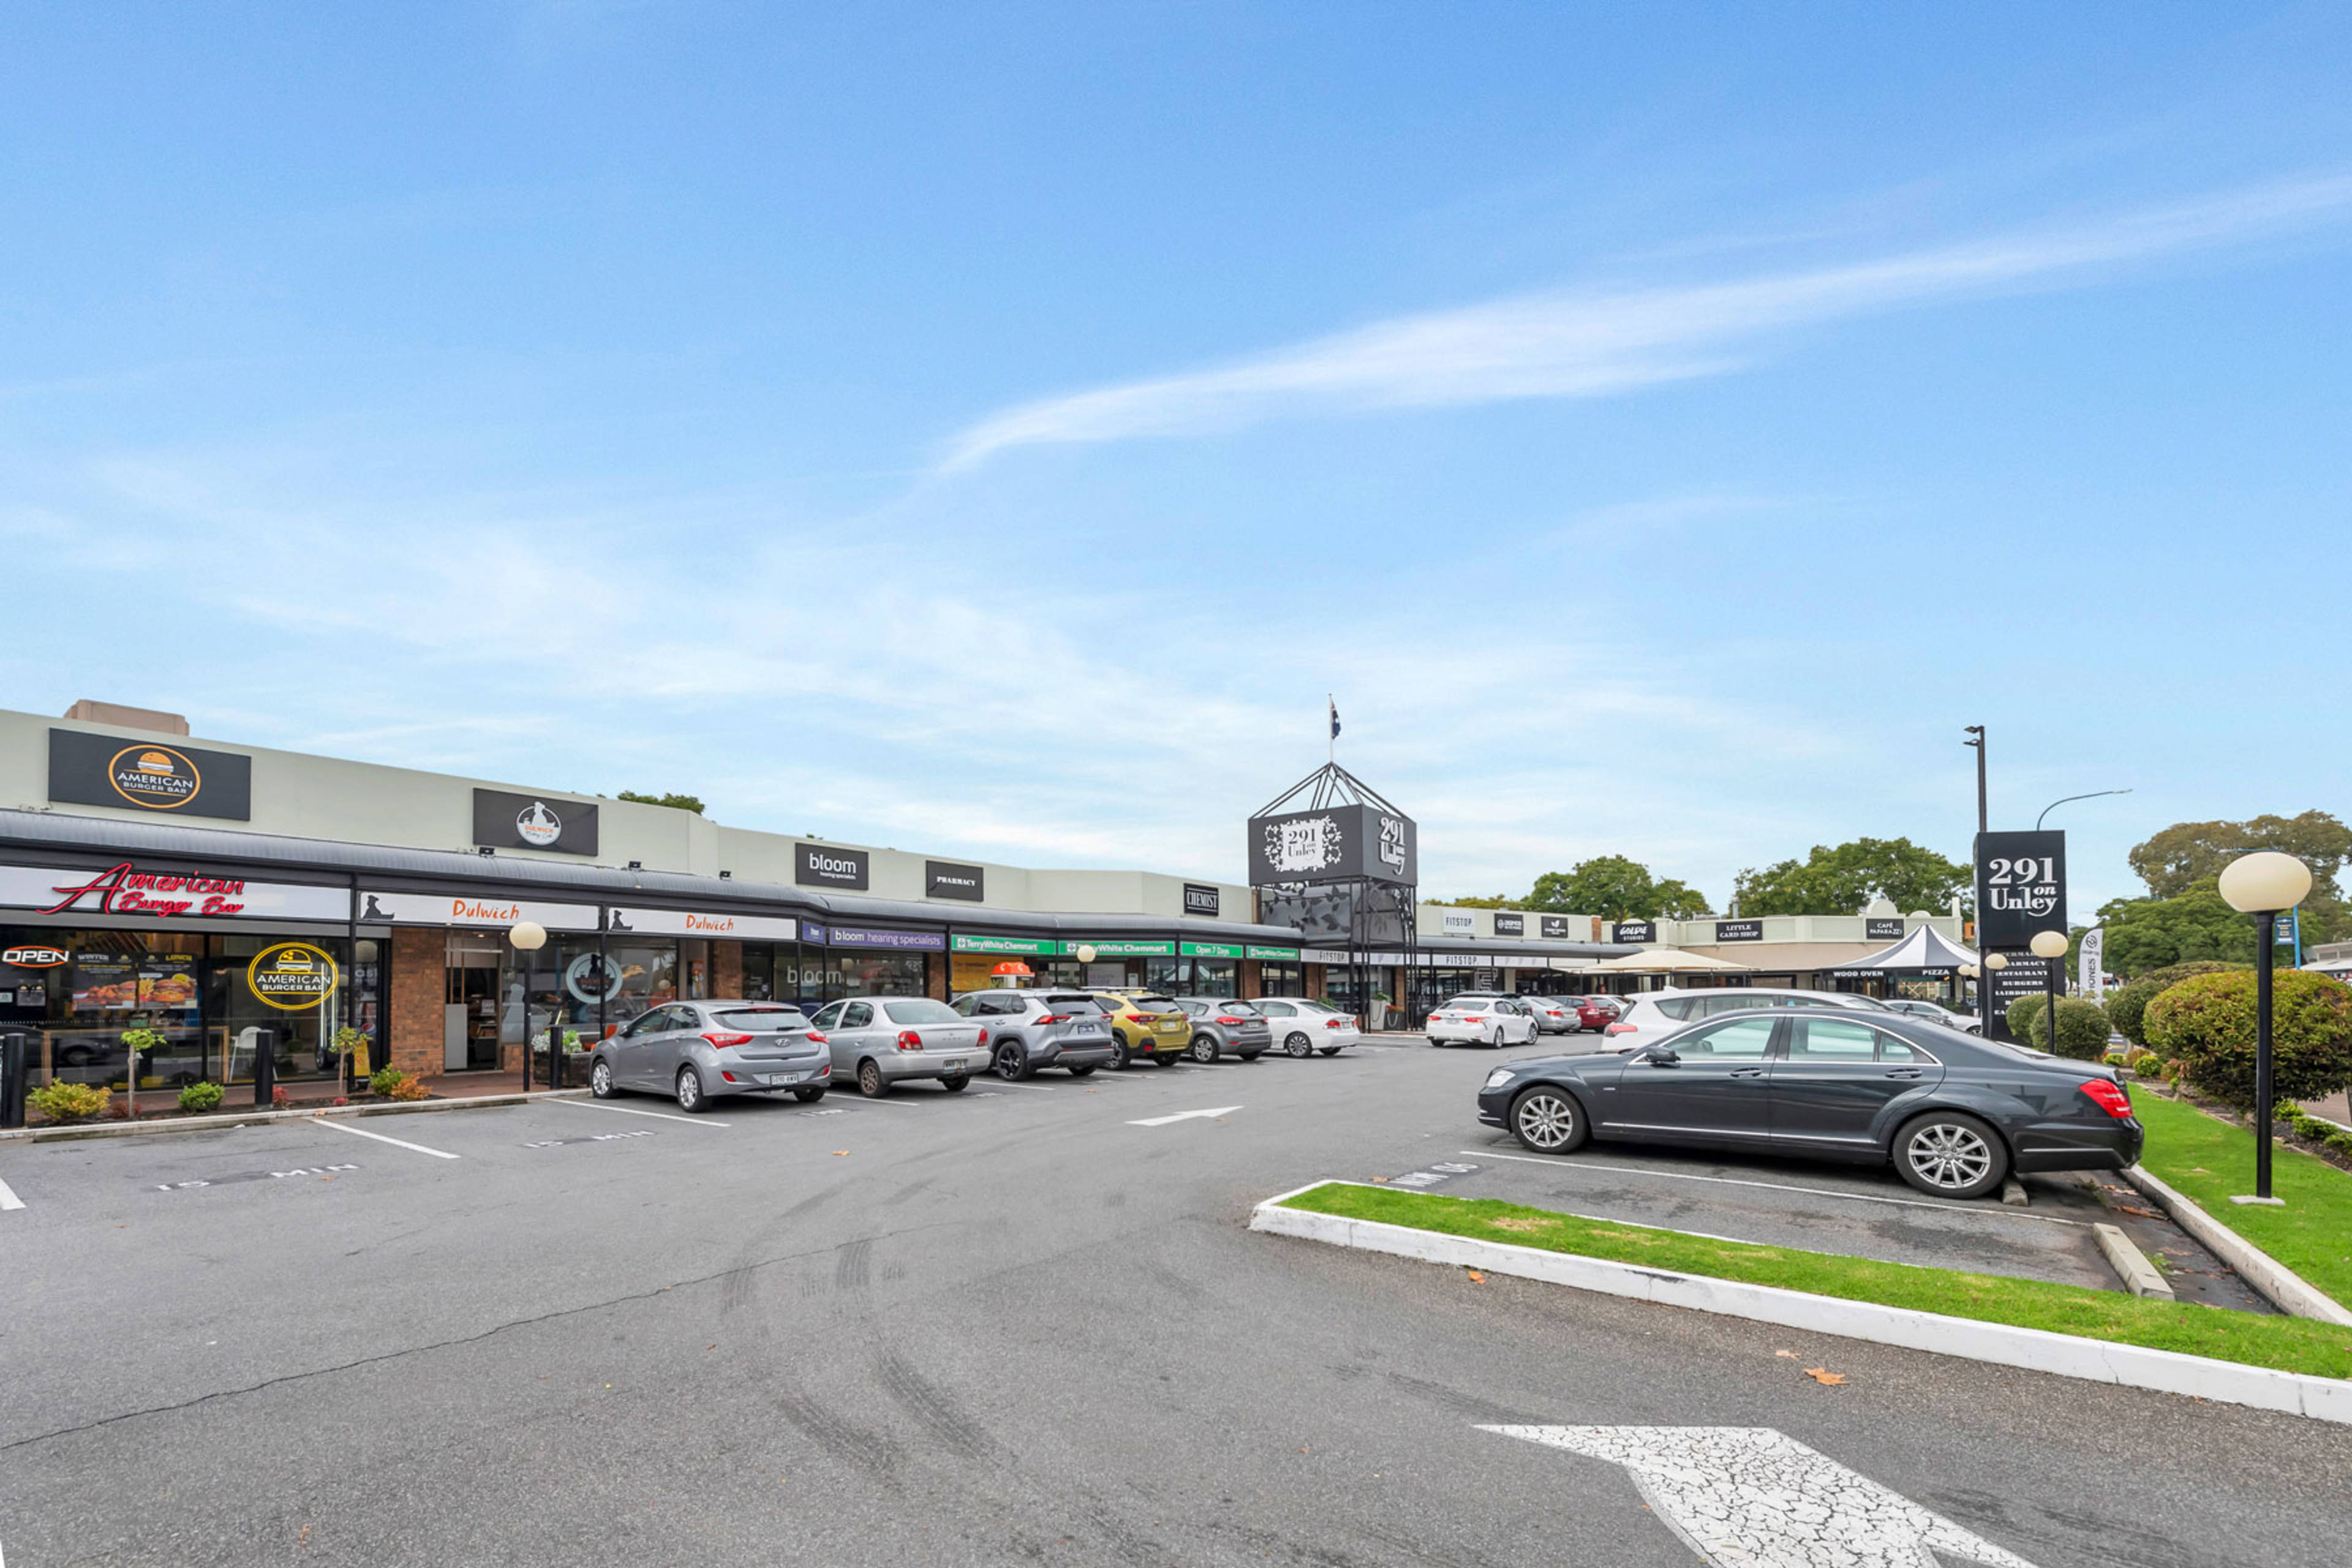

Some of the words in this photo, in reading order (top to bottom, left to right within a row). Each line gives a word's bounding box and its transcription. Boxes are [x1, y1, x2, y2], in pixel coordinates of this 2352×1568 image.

[118, 772, 193, 788] AMERICAN
[123, 782, 164, 791] BURGER
[1288, 828, 1315, 845] 291
[1380, 817, 1405, 846] 291
[1288, 843, 1316, 861] Unley
[809, 853, 856, 873] bloom
[1988, 857, 2058, 884] 291
[36, 862, 244, 914] American
[937, 876, 976, 886] PHARMACY
[2033, 886, 2057, 895] on
[118, 892, 192, 918] Burger
[201, 896, 244, 915] Bar
[1186, 891, 1217, 908] CHEMIST
[1988, 887, 2059, 917] Unley
[453, 900, 519, 920] Dulwich
[687, 914, 734, 930] Dulwich
[835, 930, 864, 941] bloom
[867, 932, 899, 946] hearing
[900, 935, 941, 946] specialists
[967, 938, 1003, 950] TerryWhite
[1005, 941, 1038, 951] Chemmart
[2, 951, 70, 962] OPEN
[1195, 945, 1211, 955] Open
[1217, 947, 1230, 957] Days
[257, 974, 331, 984] AMERICAN
[157, 1180, 210, 1191] 15
[270, 1163, 360, 1178] MIN
